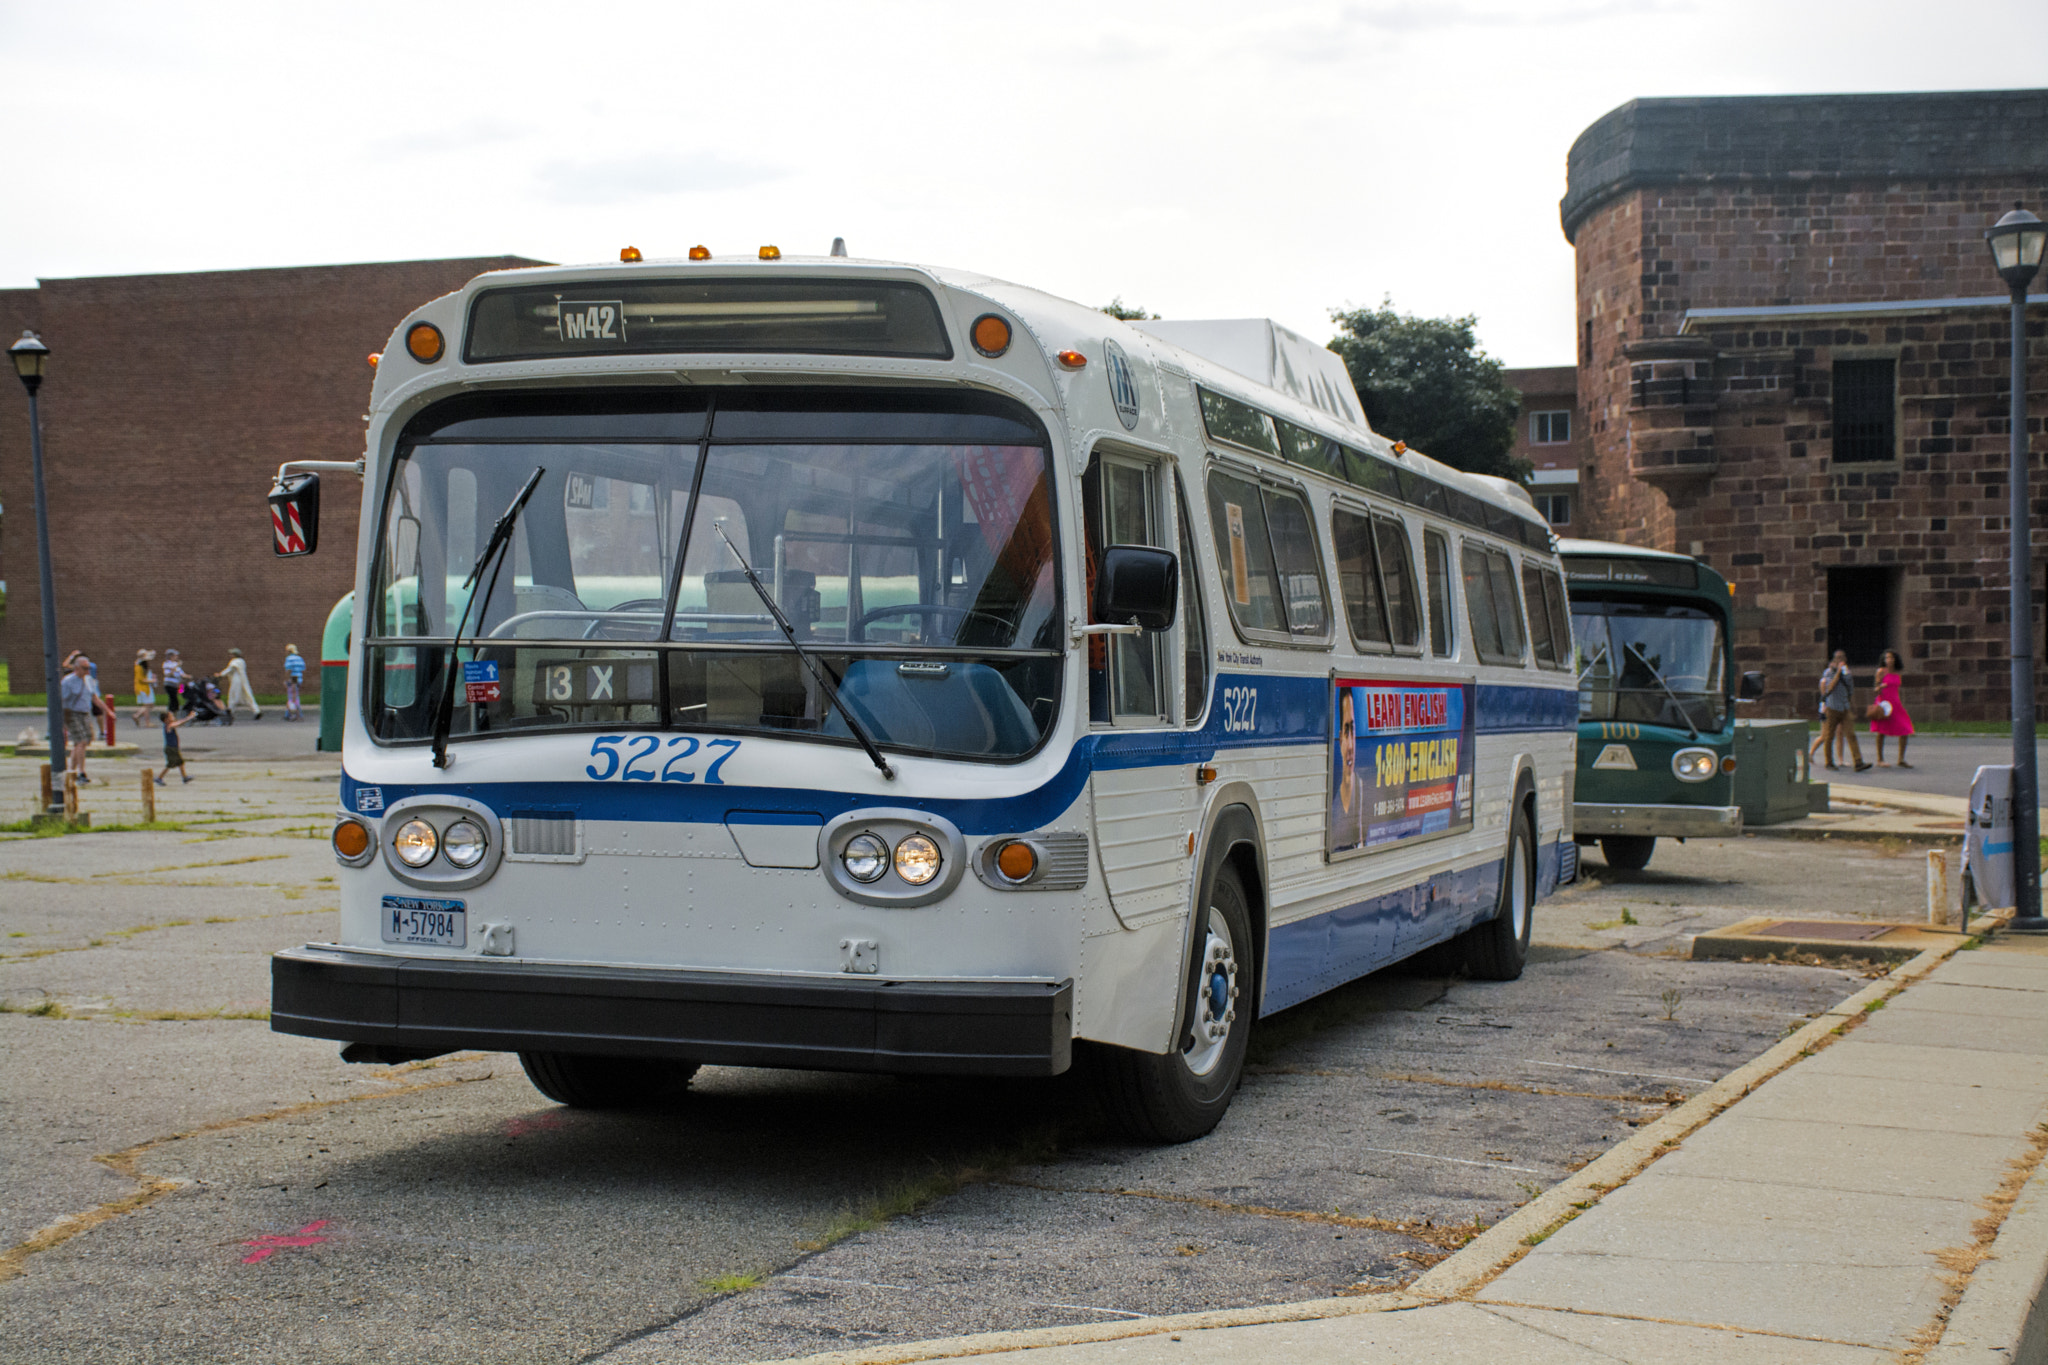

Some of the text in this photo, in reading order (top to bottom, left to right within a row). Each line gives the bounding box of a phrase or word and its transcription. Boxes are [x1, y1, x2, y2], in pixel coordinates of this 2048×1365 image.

[565, 306, 617, 339] M42
[591, 665, 613, 700] X
[1224, 687, 1257, 732] 5227
[1366, 692, 1447, 729] LEARN ENGLISH!
[586, 735, 742, 785] 5227
[401, 899, 445, 911] NEW YORK
[411, 911, 454, 937] 57984
